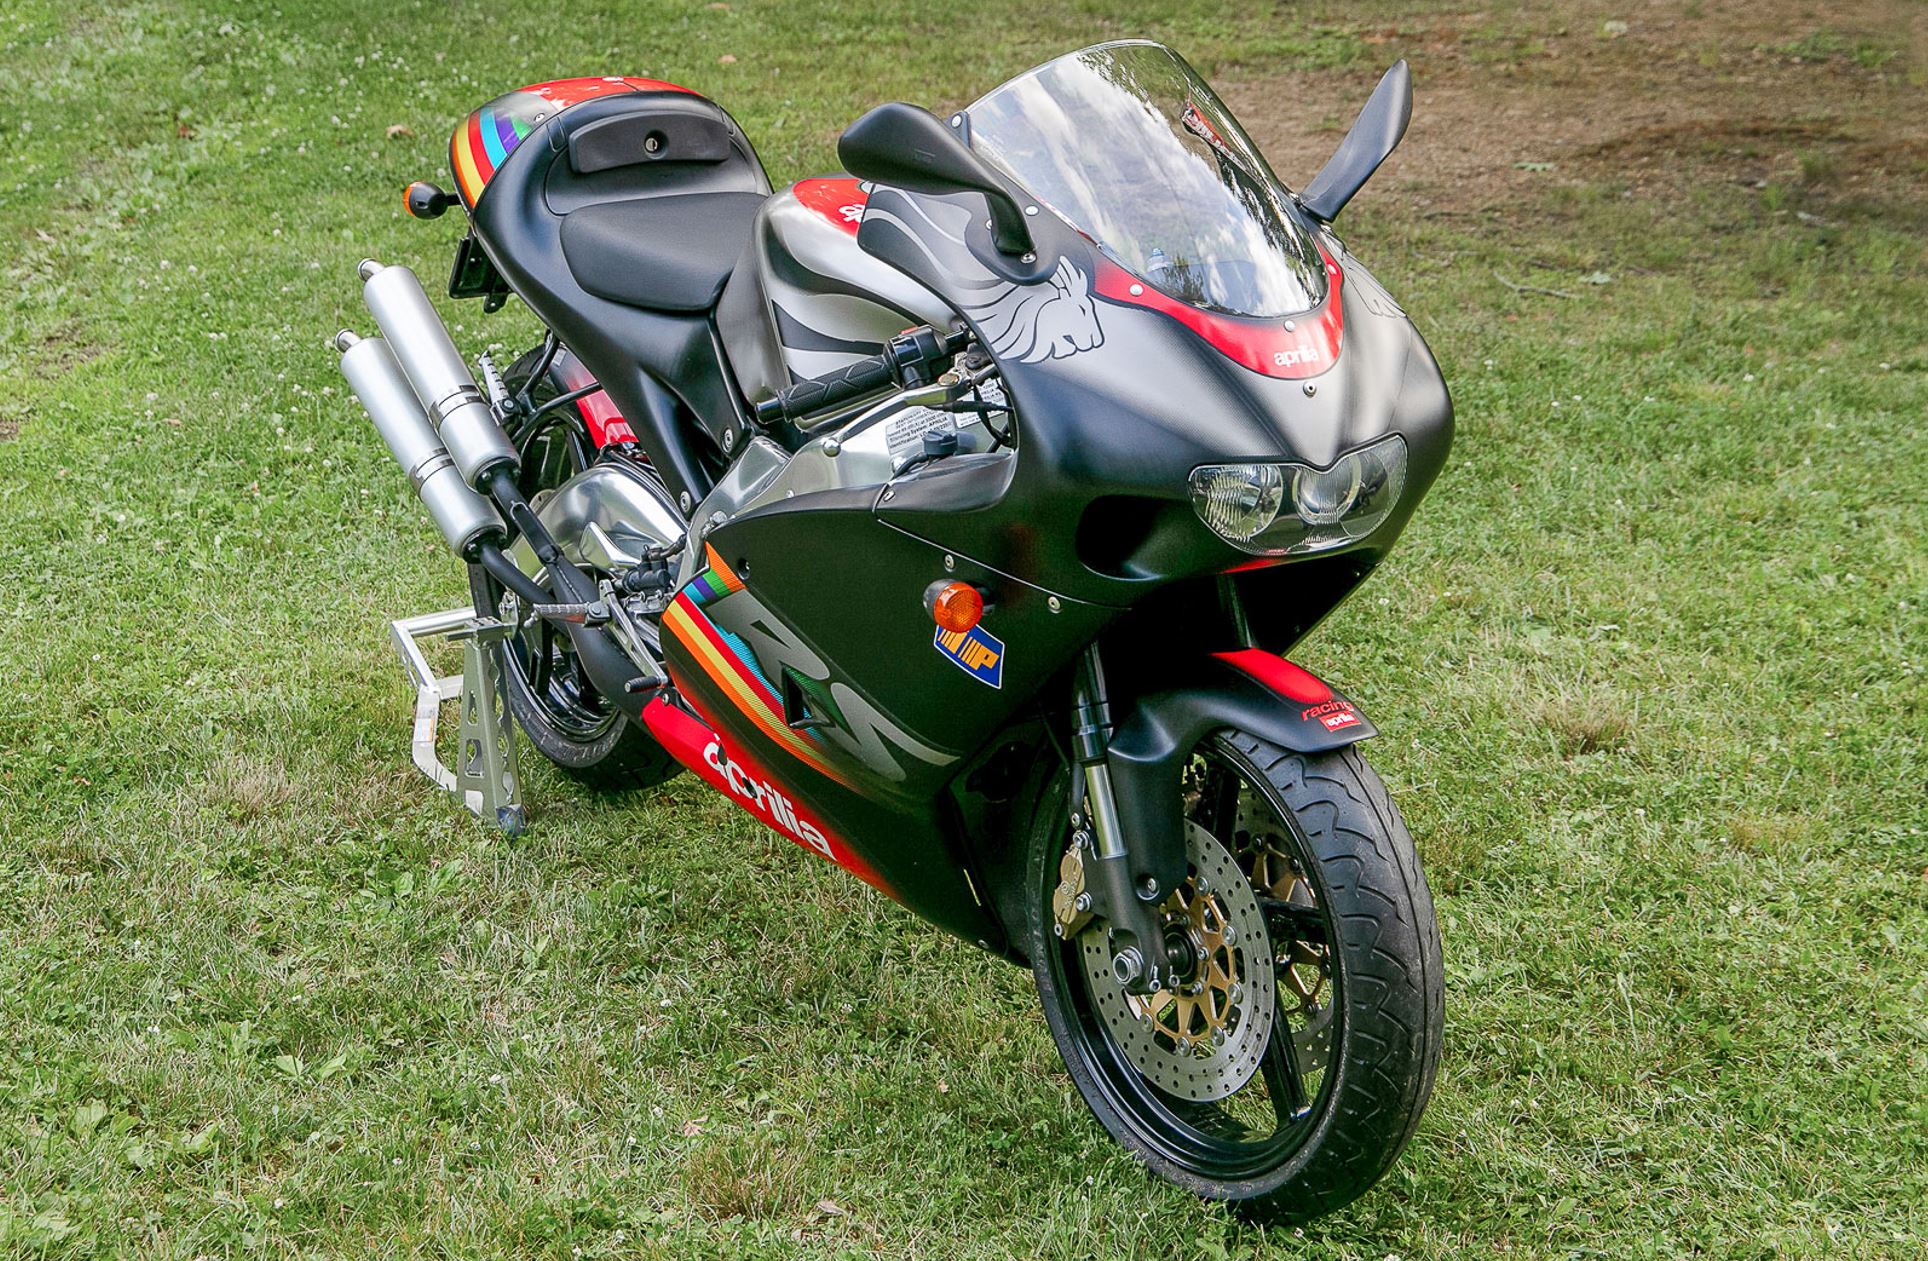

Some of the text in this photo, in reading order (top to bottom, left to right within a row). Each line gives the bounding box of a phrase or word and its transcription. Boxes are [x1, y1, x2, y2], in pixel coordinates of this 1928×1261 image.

[1273, 345, 1319, 367] aprilia
[1301, 700, 1355, 721] racing
[703, 733, 837, 861] aprilia
